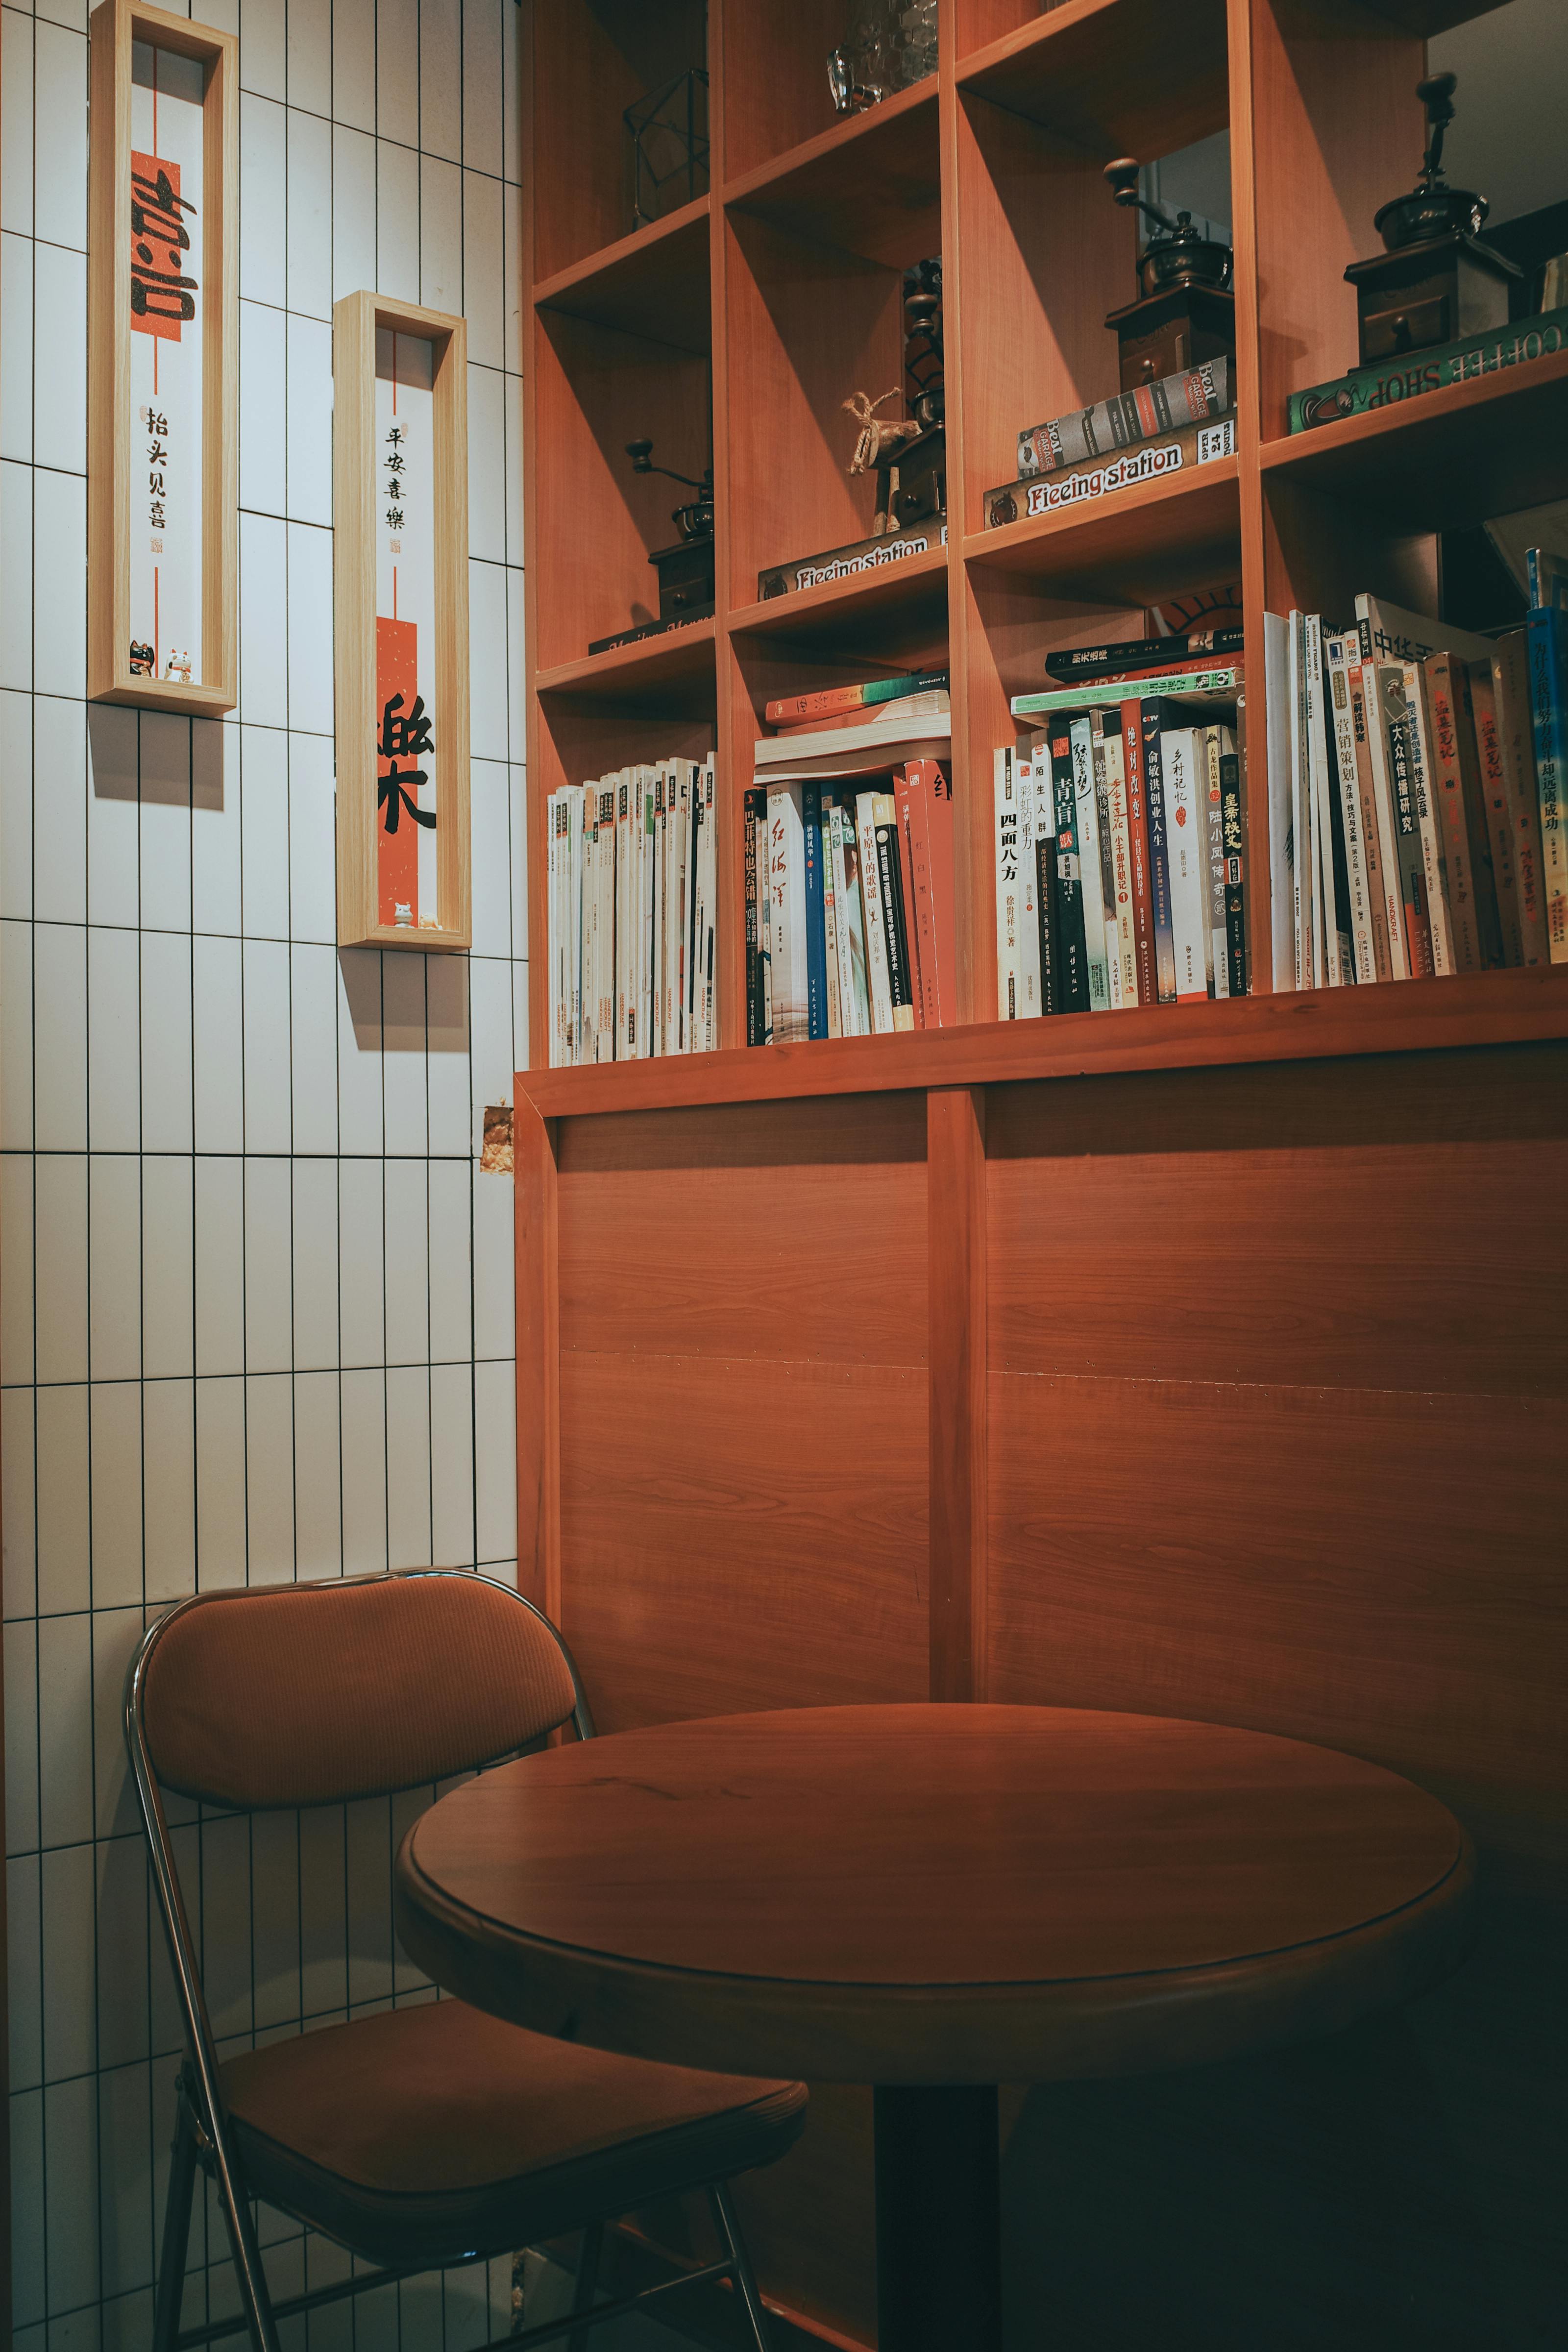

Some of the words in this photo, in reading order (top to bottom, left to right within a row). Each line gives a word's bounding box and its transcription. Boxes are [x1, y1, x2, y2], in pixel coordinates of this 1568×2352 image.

[1198, 362, 1217, 401] Best
[1447, 324, 1563, 385] COFFEE
[1191, 376, 1207, 417] GARAGE
[1369, 360, 1441, 411] SHOP
[1040, 431, 1054, 469] GARAGE
[1046, 419, 1063, 455] Best
[1212, 433, 1220, 452] 24
[146, 407, 168, 529] 抬头见喜
[1072, 649, 1108, 664] 别无选择
[1359, 621, 1370, 655] 中华手工
[1337, 718, 1355, 781] 营销策划
[1353, 702, 1366, 743] 解读韩寒
[1406, 701, 1422, 764] 毁灭者还是创造者
[1435, 701, 1456, 759] 盗墓笔记
[1482, 720, 1503, 779] 盗墓笔记
[1534, 642, 1559, 831] 为什么我们努力奋斗却远离成功
[1095, 760, 1109, 819] 社会病诊所
[1127, 727, 1141, 820] 绝对改变
[1171, 748, 1187, 804] 乡村记忆
[1209, 748, 1218, 788] 古龙作品集
[1392, 725, 1413, 833] 大众传播研究
[1414, 767, 1428, 819] 核子风云录
[1020, 785, 1032, 850] 彩虹的重力
[1036, 766, 1047, 833] 陌生人群
[1054, 778, 1074, 826] 青盲
[1148, 750, 1164, 847] 俞敏洪创业人生
[1345, 784, 1358, 842] 方法、技巧与文案
[744, 810, 757, 902] 巴菲特也会错
[772, 818, 786, 907] 红海洋
[863, 824, 877, 899] 平原上的歌谣
[1001, 813, 1018, 882] 四面八方
[1115, 834, 1127, 890] 小干部升职记
[1209, 811, 1226, 897] 陆小凤传奇
[886, 908, 899, 971] 宝可梦视觉艺术史
[1006, 895, 1015, 927] 徐贵祥
[1387, 894, 1399, 943] HANDICRAFT
[1006, 936, 1015, 948] 著
